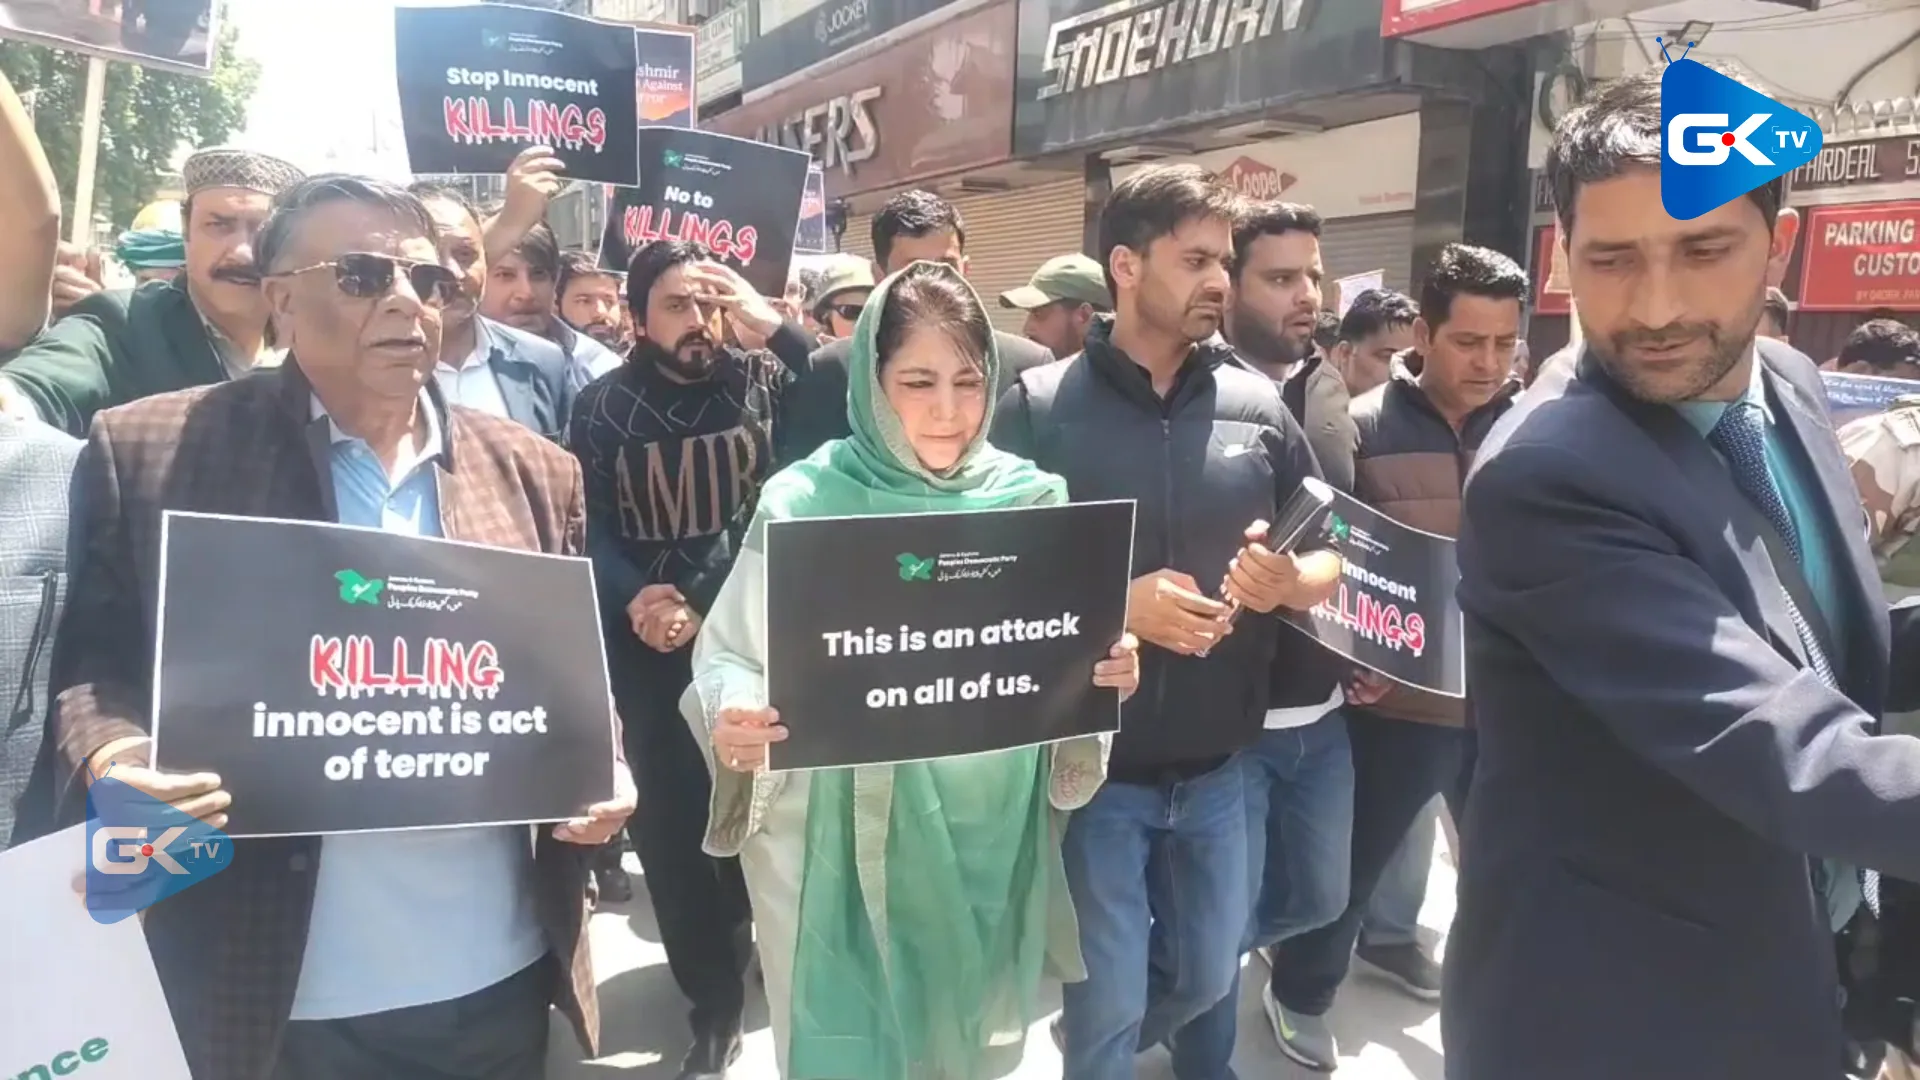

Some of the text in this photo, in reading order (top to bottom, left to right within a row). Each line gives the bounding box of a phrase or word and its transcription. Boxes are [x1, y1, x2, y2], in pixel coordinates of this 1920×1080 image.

[446, 66, 599, 97] Stop Innocent
[637, 63, 680, 79] shmir
[443, 96, 606, 152] KILLINGS
[664, 185, 714, 209] No to
[624, 204, 758, 267] KILLINGS
[1825, 218, 1915, 246] PARKING
[822, 611, 1080, 657] This is an attack
[1310, 583, 1425, 657] LLINGS
[310, 635, 504, 699] KILLING
[866, 672, 1040, 708] on all of us.
[253, 702, 548, 738] innocent is act
[324, 746, 490, 781] of terror
